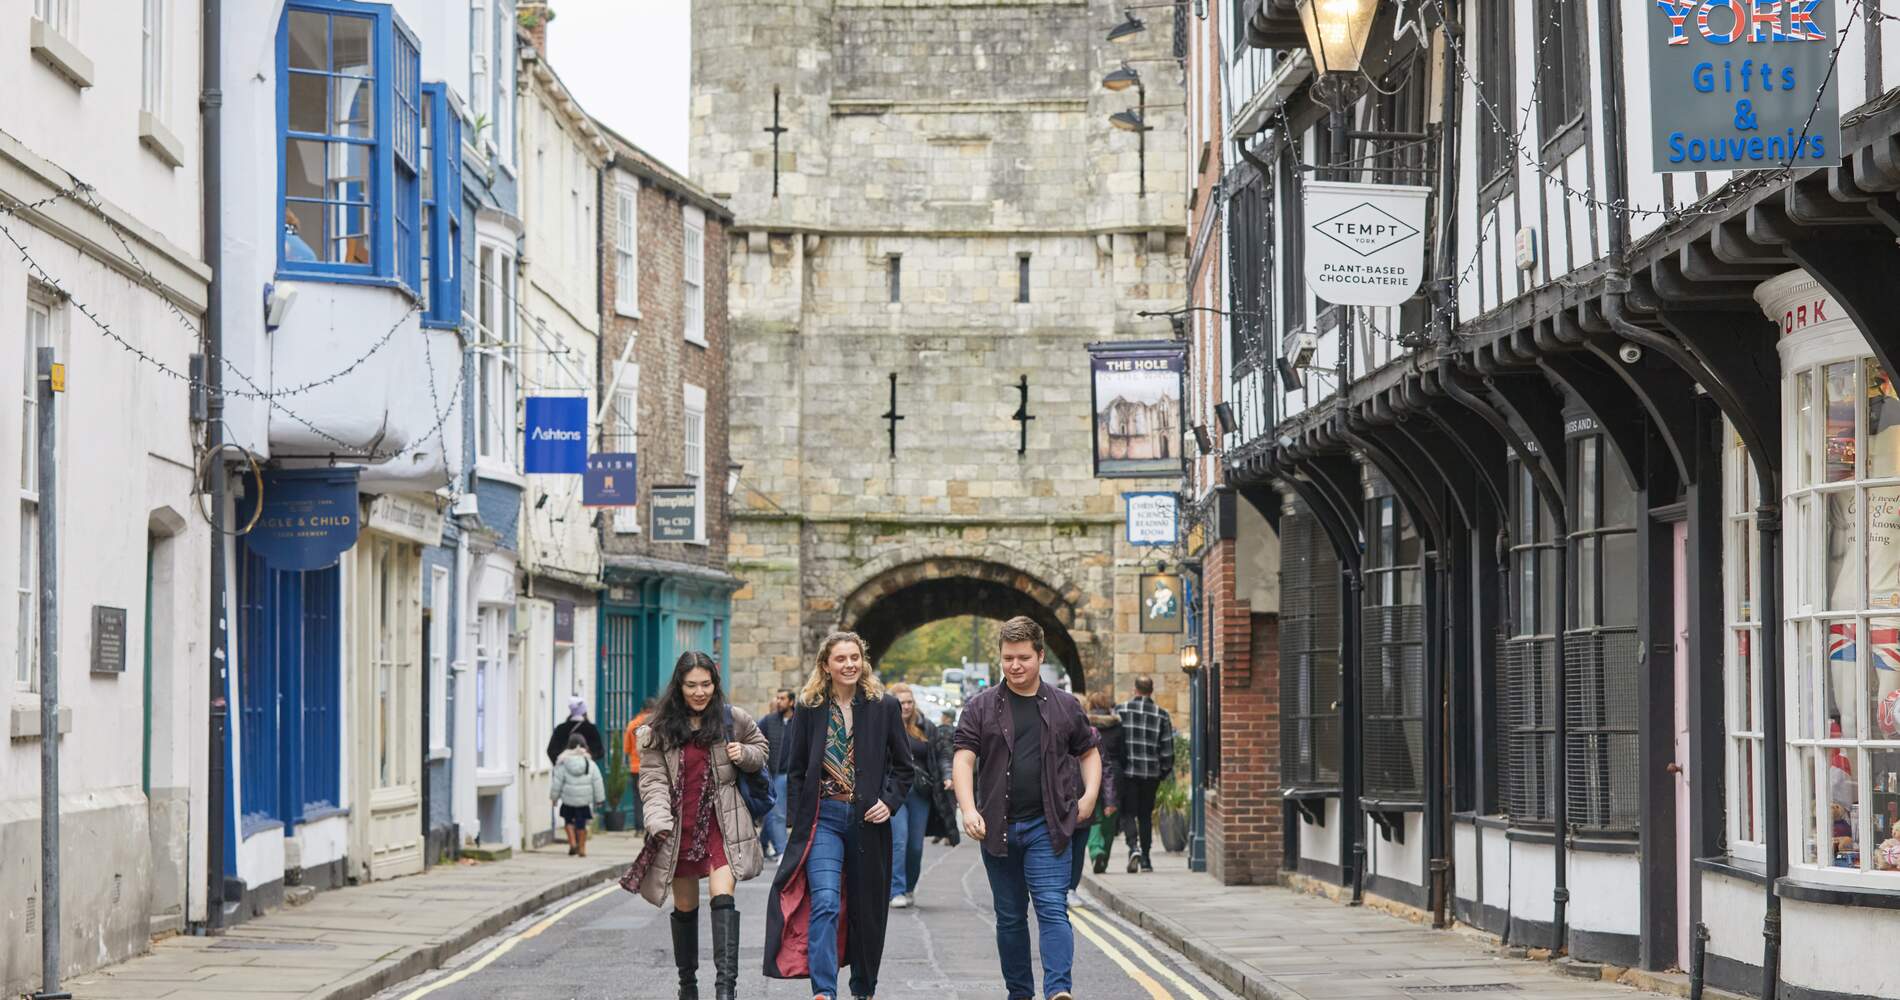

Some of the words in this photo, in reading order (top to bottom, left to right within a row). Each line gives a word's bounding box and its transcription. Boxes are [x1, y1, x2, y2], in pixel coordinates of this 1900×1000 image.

[1656, 0, 1827, 45] YORK
[1691, 59, 1796, 93] Gifts
[1733, 98, 1759, 131] &
[1667, 127, 1825, 163] Souvenirs
[1335, 223, 1398, 236] TEMPT
[1324, 264, 1405, 275] PLANT-BASED
[1319, 274, 1409, 286] CHOCOLATERIE
[1105, 360, 1132, 371] THE
[1134, 359, 1169, 370] HOLE
[1578, 418, 1591, 429] AND
[531, 426, 581, 441] Ashtons
[310, 516, 350, 527] CHILD
[655, 517, 671, 527] The
[1140, 528, 1164, 536] ROOM
